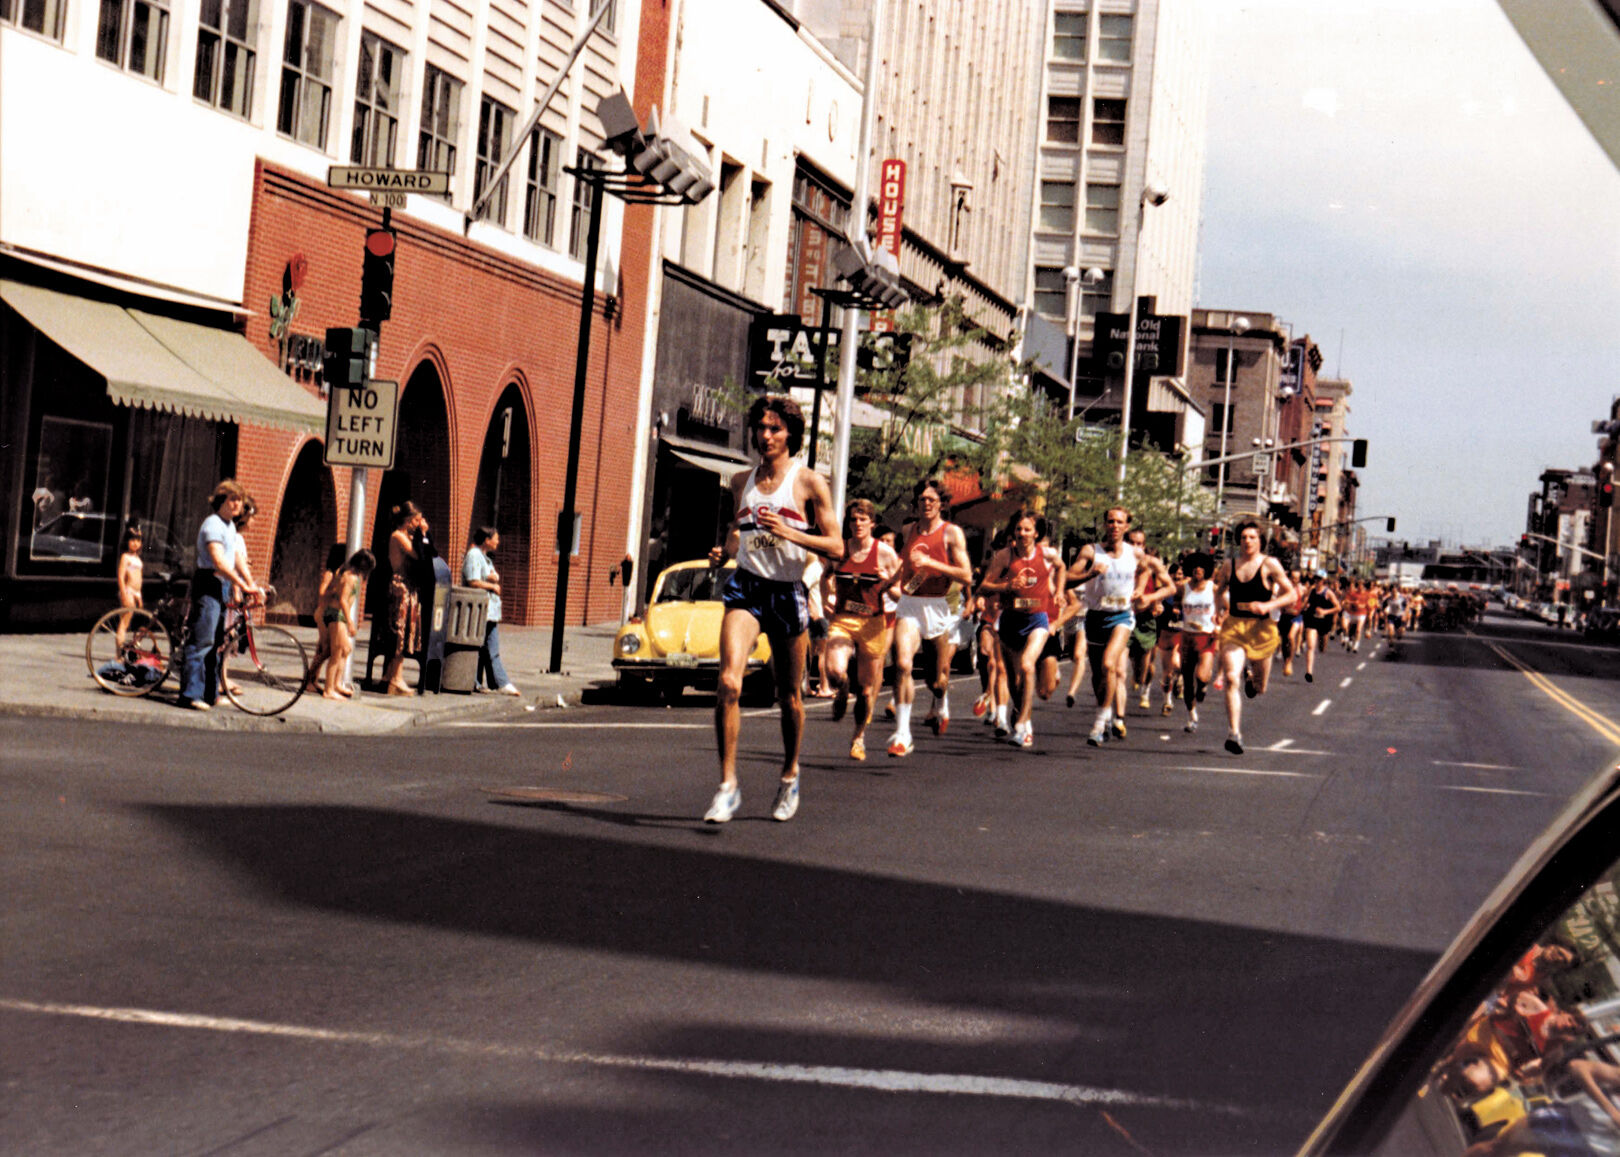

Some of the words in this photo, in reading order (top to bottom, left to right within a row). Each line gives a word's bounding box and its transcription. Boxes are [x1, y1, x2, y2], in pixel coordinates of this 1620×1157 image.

[346, 171, 432, 188] HOWARD
[370, 194, 378, 205] N
[385, 195, 404, 206] 100
[881, 164, 900, 251] HOUSE
[1140, 319, 1161, 330] Old
[1110, 328, 1160, 340] Natonal
[1133, 341, 1159, 351] ank
[348, 388, 378, 410] NO
[338, 415, 384, 434] LEFT
[336, 437, 384, 457] TURN
[753, 535, 776, 549] 002
